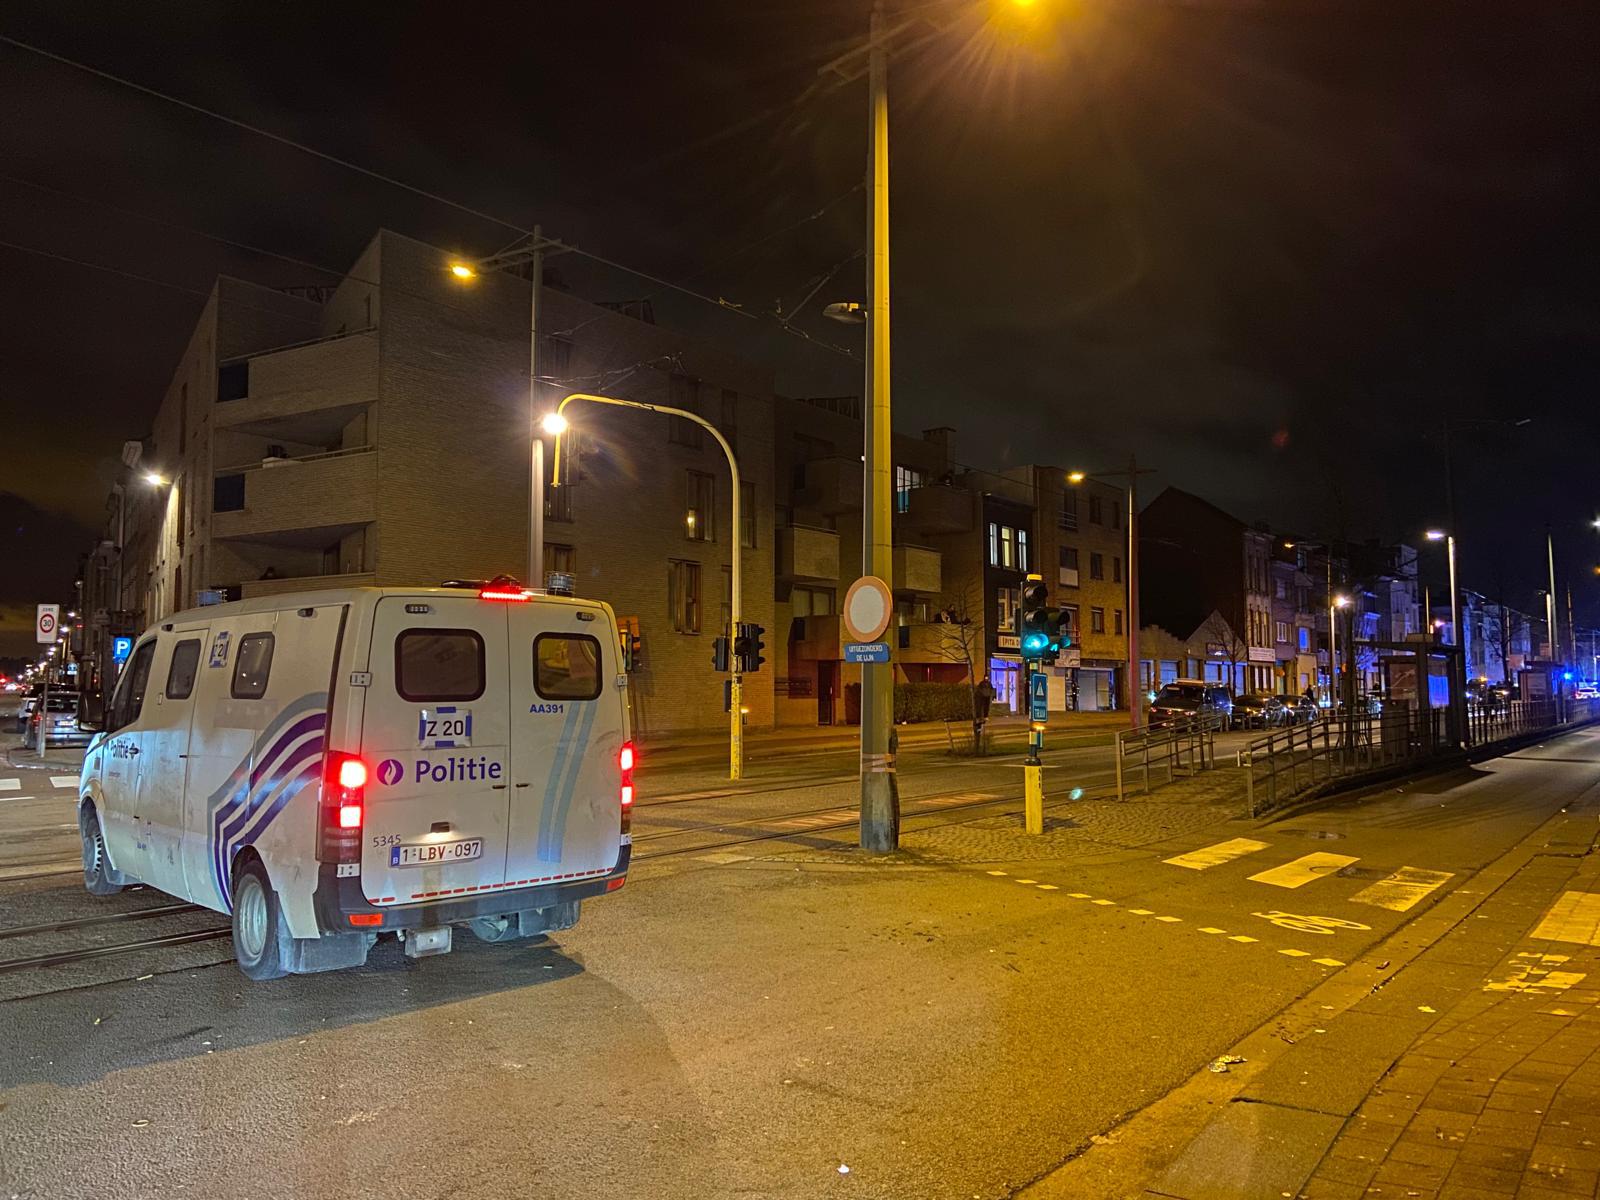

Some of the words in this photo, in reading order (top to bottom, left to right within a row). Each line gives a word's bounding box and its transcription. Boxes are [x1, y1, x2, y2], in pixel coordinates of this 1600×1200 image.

[43, 619, 52, 628] 30
[116, 641, 128, 655] P
[849, 645, 882, 653] UITGEZONDERD
[529, 704, 564, 714] AA391
[427, 721, 438, 737] Z
[443, 720, 464, 736] 20
[415, 757, 501, 783] Politie
[373, 834, 401, 847] 5345
